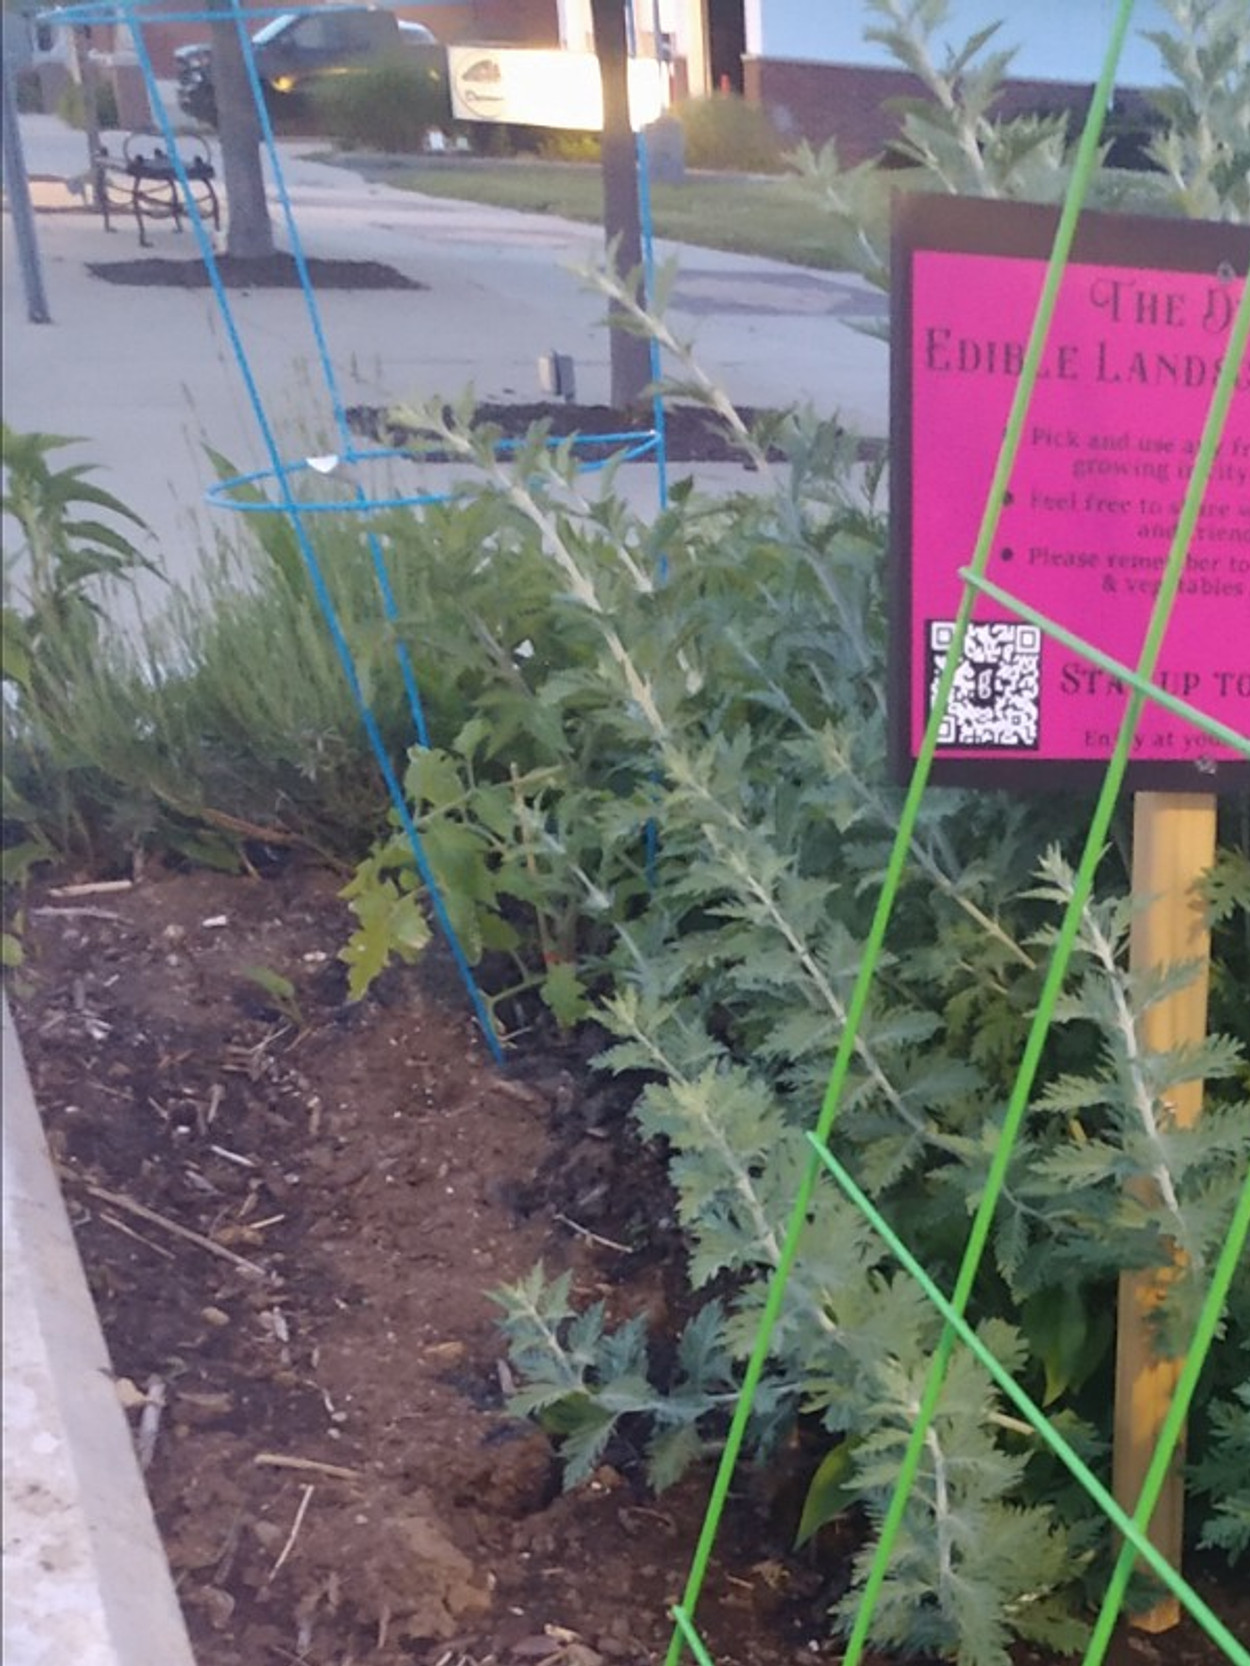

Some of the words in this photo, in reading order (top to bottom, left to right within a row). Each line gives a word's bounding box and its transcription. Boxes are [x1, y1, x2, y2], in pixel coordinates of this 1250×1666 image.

[1089, 277, 1185, 328] THE
[925, 326, 1079, 381] EDIBE
[1032, 427, 1080, 449] Pick
[1088, 433, 1130, 451] and
[1072, 458, 1168, 485] growing
[1085, 491, 1131, 514] free
[1140, 499, 1162, 516] to
[1029, 546, 1098, 569] Please
[1229, 556, 1250, 574] to
[1102, 573, 1117, 593] &
[1154, 732, 1173, 747] at
